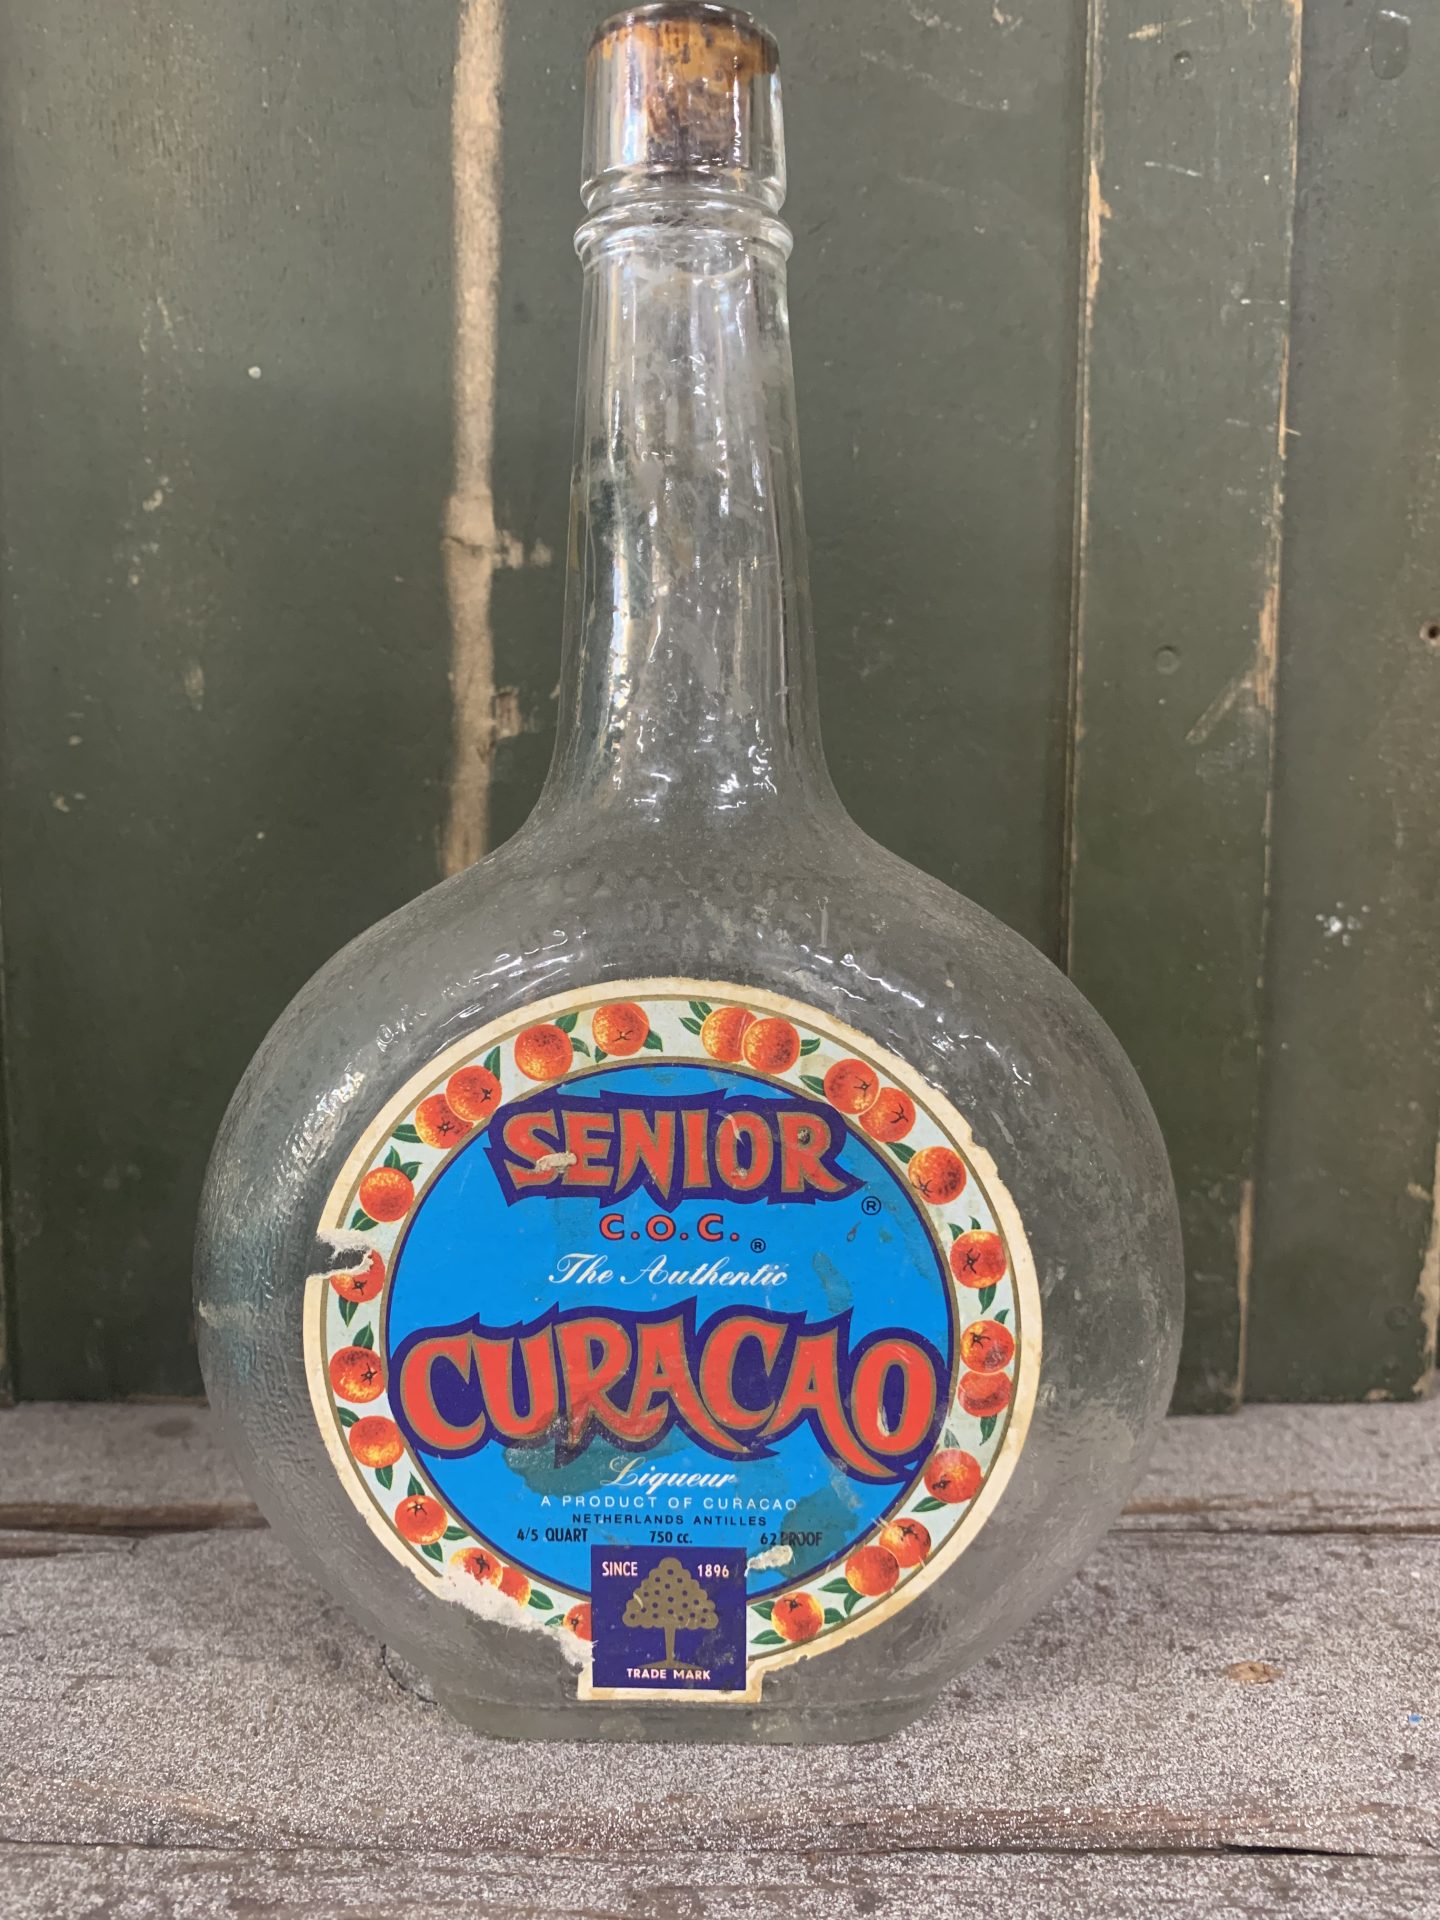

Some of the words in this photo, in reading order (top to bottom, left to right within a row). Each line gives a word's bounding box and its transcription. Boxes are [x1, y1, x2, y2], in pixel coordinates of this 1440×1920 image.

[499, 1107, 850, 1200] SENIOR
[599, 1213, 741, 1242] C.O.C.
[548, 1253, 613, 1285] The
[619, 1254, 788, 1286] Authentic
[400, 1314, 937, 1479] CURACAO
[601, 1456, 736, 1495] Liqueur
[540, 1495, 552, 1508] A
[562, 1495, 657, 1508] PRODUCT
[668, 1497, 693, 1509] OF
[703, 1498, 797, 1511] CURACAO
[572, 1513, 684, 1525] NETHERLANDS
[693, 1516, 767, 1527] ANTILLES
[516, 1530, 539, 1542] 4/5
[545, 1527, 589, 1543] QUART
[649, 1530, 673, 1544] 750
[676, 1531, 693, 1544] cc.
[759, 1530, 777, 1546] 62
[780, 1531, 823, 1547] PROOF
[601, 1561, 638, 1577] SINCE
[697, 1564, 730, 1578] 1896
[626, 1667, 667, 1679] TRADE
[673, 1669, 711, 1680] MARK
